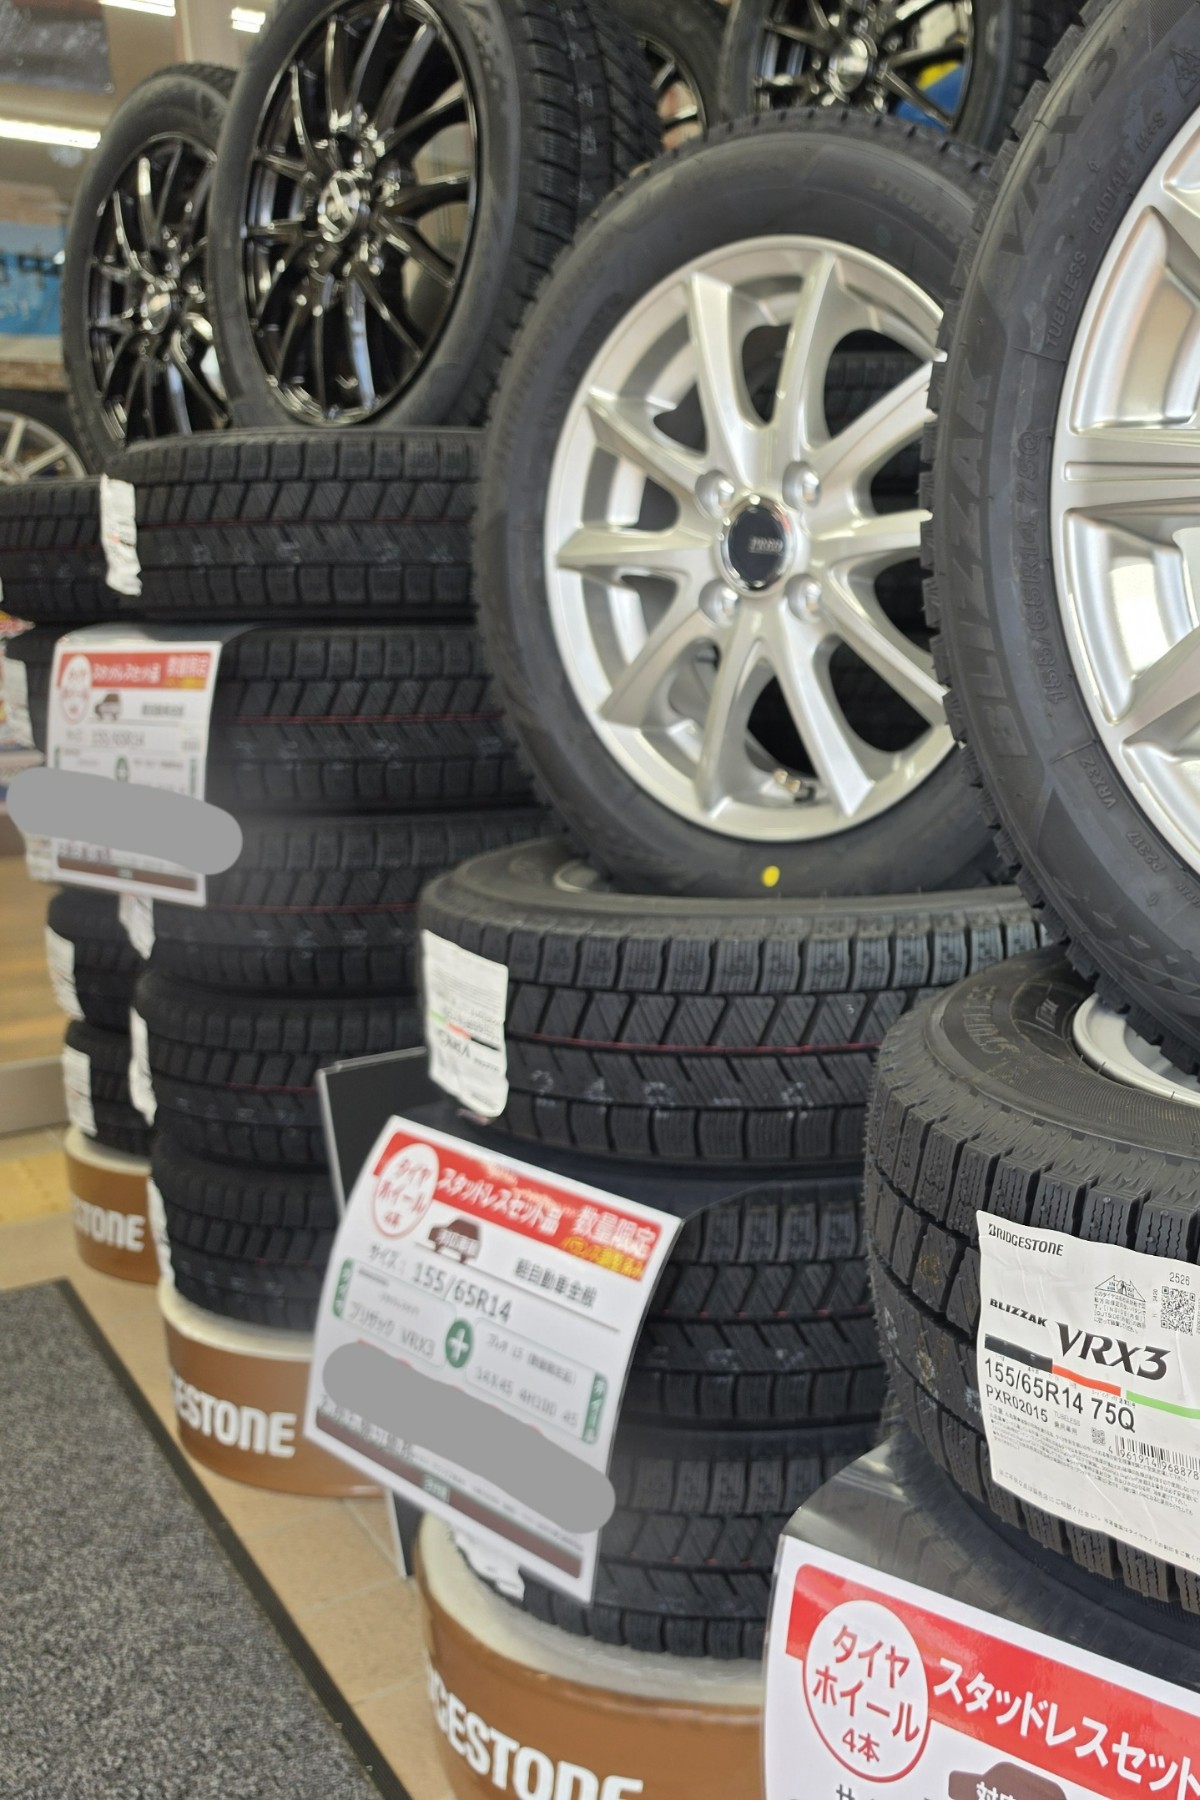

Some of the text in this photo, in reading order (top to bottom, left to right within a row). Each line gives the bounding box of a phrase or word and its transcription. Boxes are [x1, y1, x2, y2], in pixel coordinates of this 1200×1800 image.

[1046, 250, 1088, 348] TUBELESS
[952, 358, 1028, 757] BLIZZAK
[571, 1206, 656, 1257] 数量限定
[988, 1223, 1064, 1257] BRIDGESTONE
[413, 1262, 512, 1323] 155/65R14
[514, 1258, 597, 1307] 軽自動車全般
[1169, 1272, 1190, 1286] 2526
[989, 1298, 1048, 1327] BLIZZAK
[1056, 1321, 1171, 1381] VRX3
[984, 1358, 1083, 1414] 155/65R14
[1091, 1397, 1136, 1433] 75Q
[986, 1384, 1048, 1423] PXR02015
[1120, 1449, 1157, 1468] 961914
[1161, 1461, 1199, 1480] 968878
[833, 1625, 911, 1688] タイヤ
[813, 1665, 920, 1742] ホイール
[842, 1729, 880, 1763] 4本
